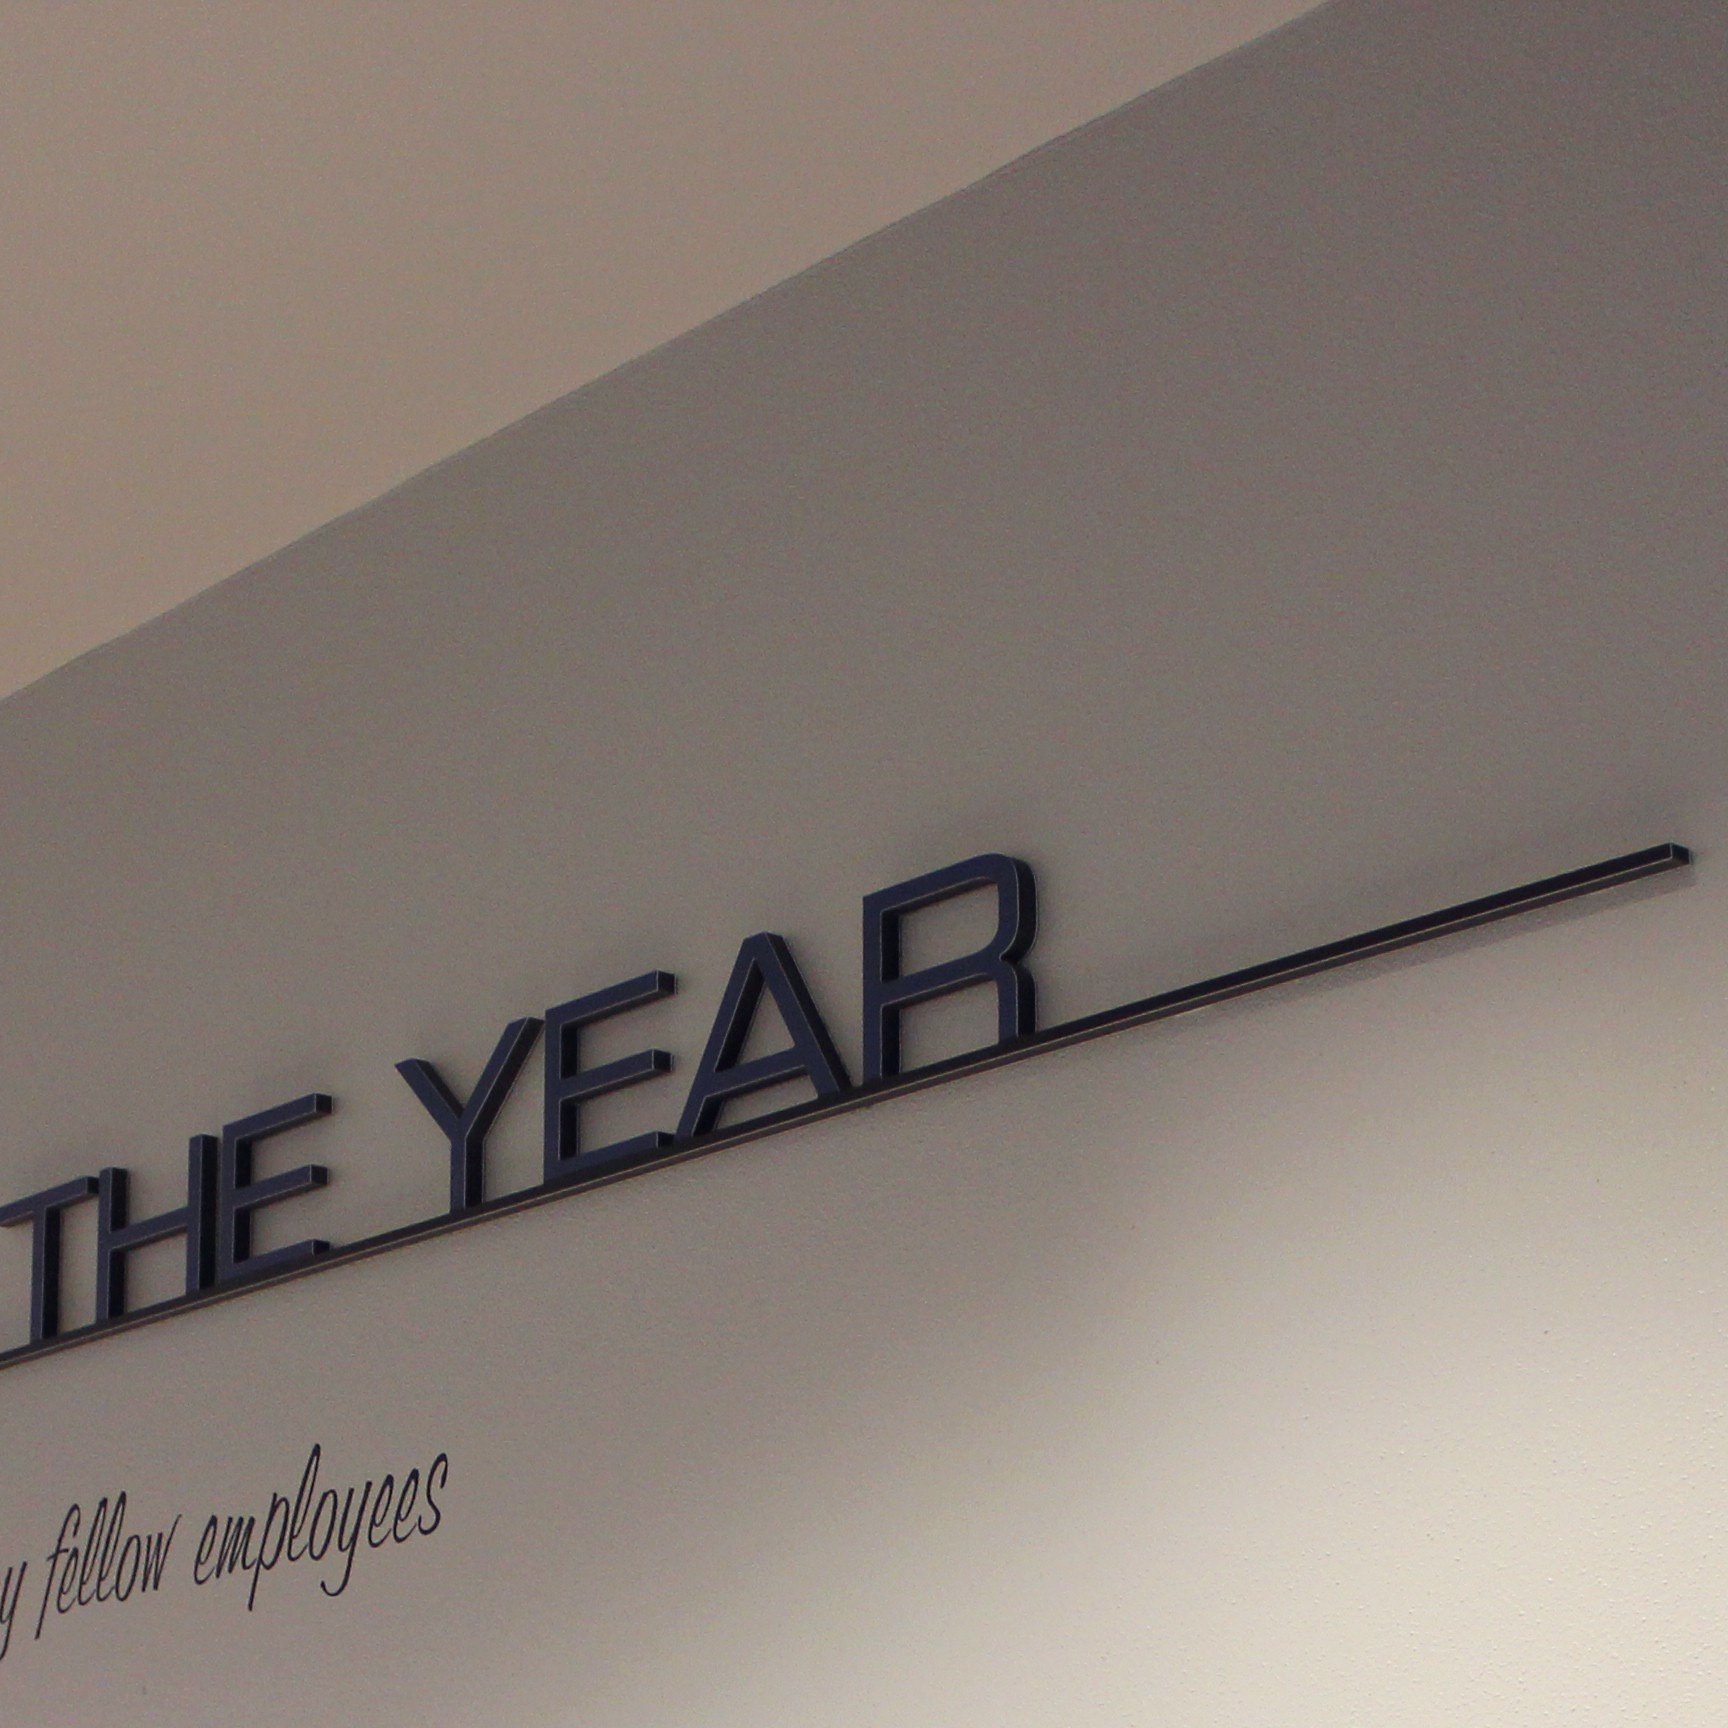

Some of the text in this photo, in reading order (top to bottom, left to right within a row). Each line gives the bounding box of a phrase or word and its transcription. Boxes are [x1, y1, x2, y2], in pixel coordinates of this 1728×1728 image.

[393, 850, 1040, 1211] YEAR
[35, 1489, 180, 1638] fellow
[192, 1443, 450, 1612] employees
